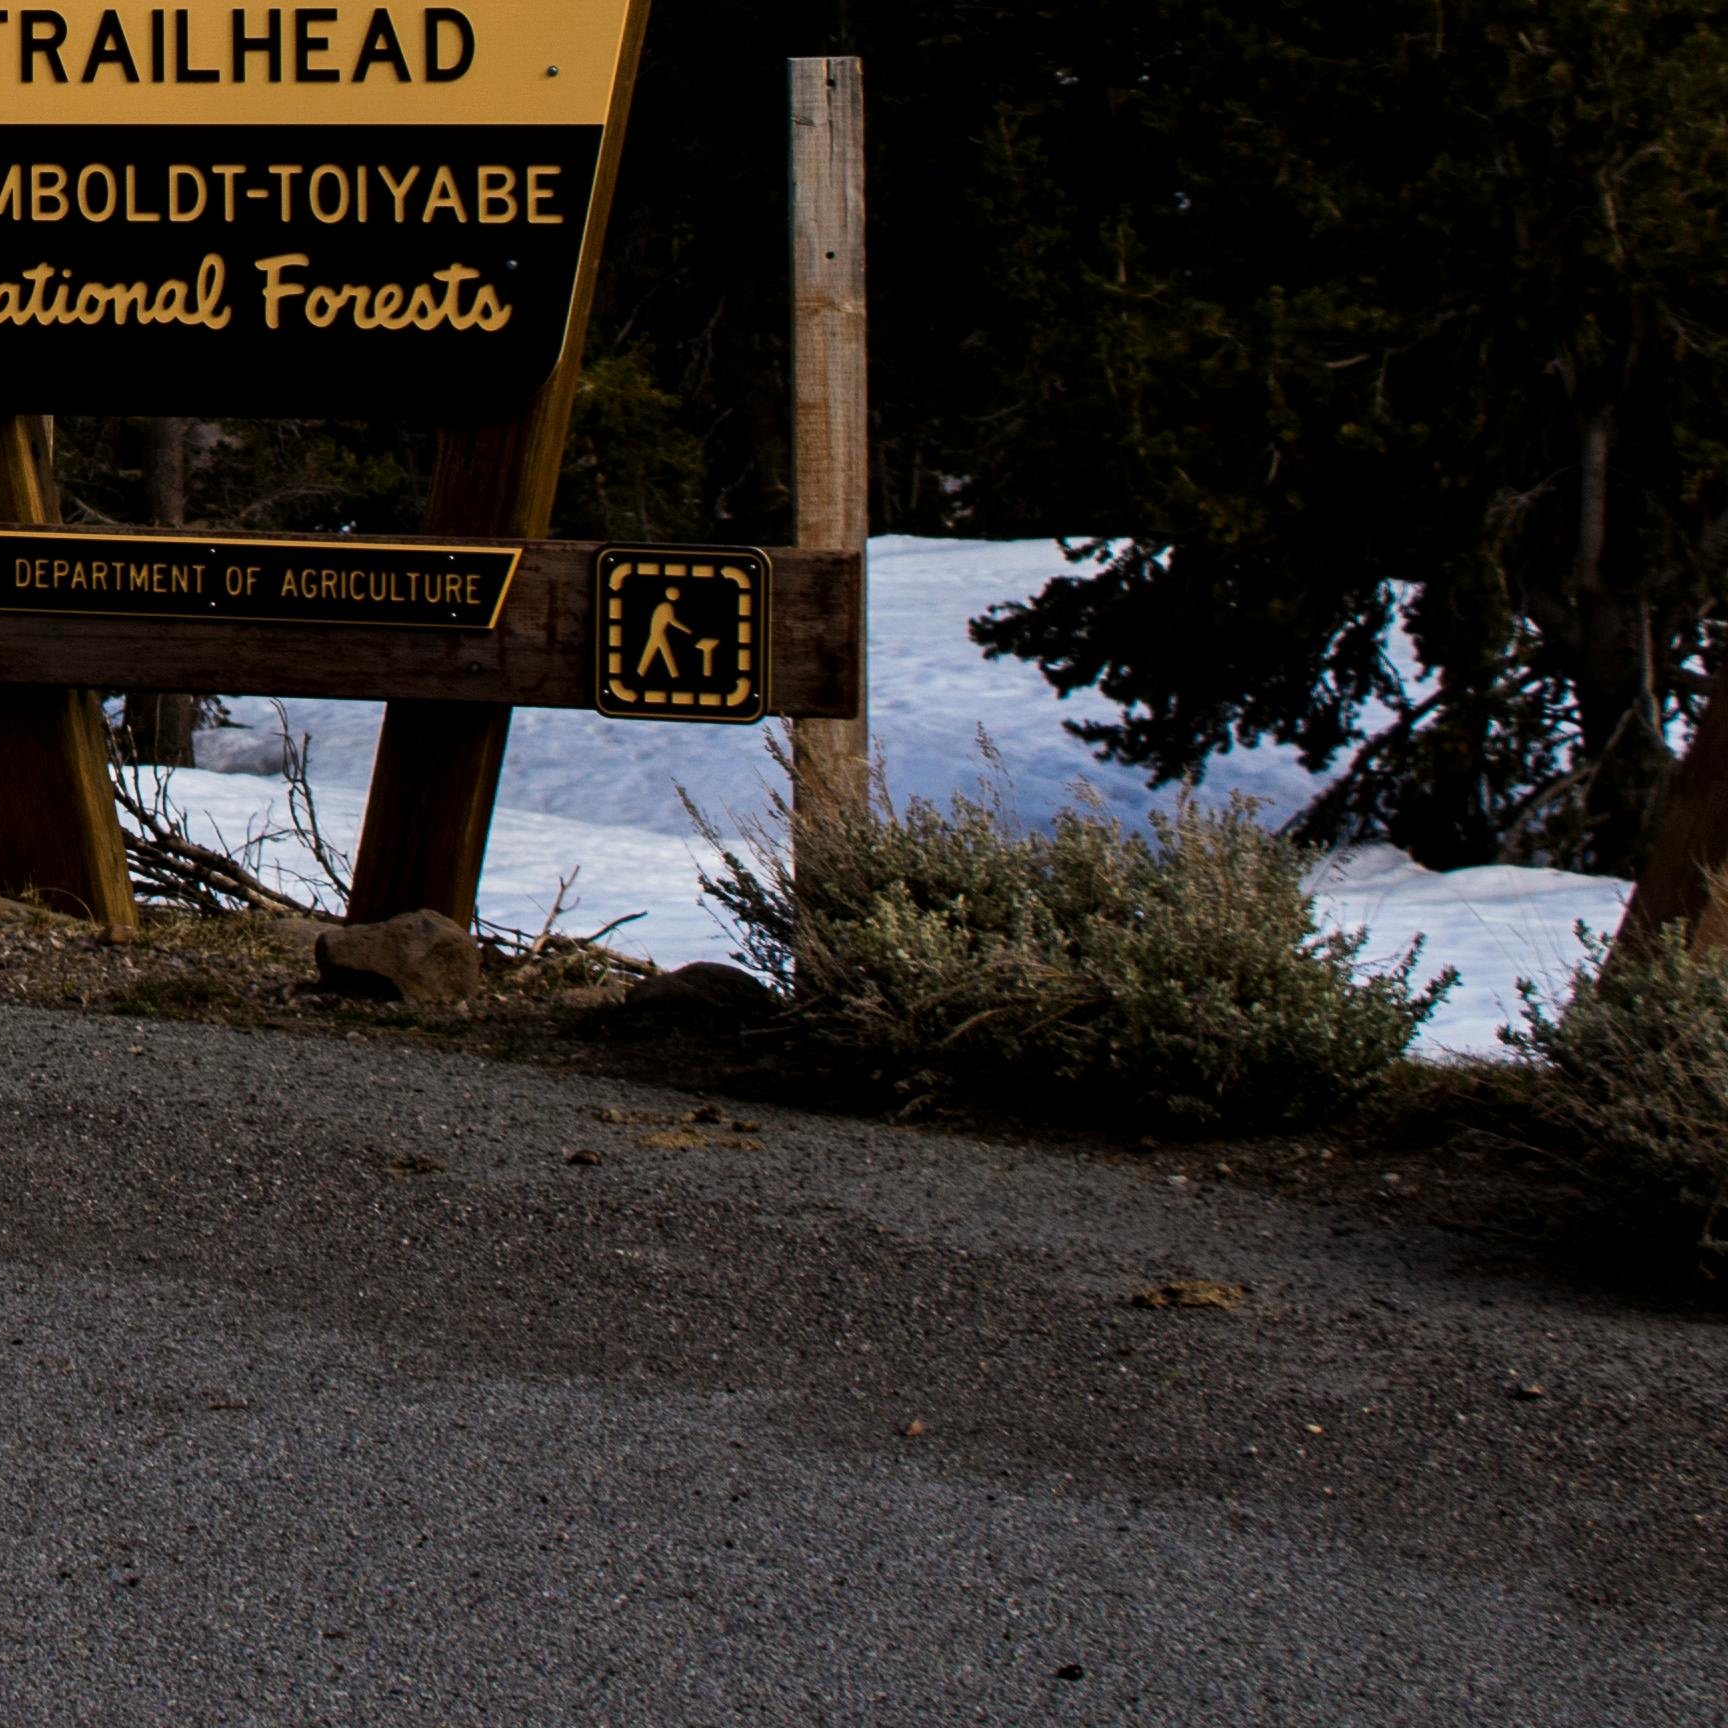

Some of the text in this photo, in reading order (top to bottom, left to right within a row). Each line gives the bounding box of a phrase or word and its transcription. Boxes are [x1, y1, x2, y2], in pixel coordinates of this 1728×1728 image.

[254, 253, 513, 332] Forests
[14, 557, 207, 594] DEPARTMENT
[225, 564, 263, 597] OF
[280, 567, 482, 605] AGRICULTURE
